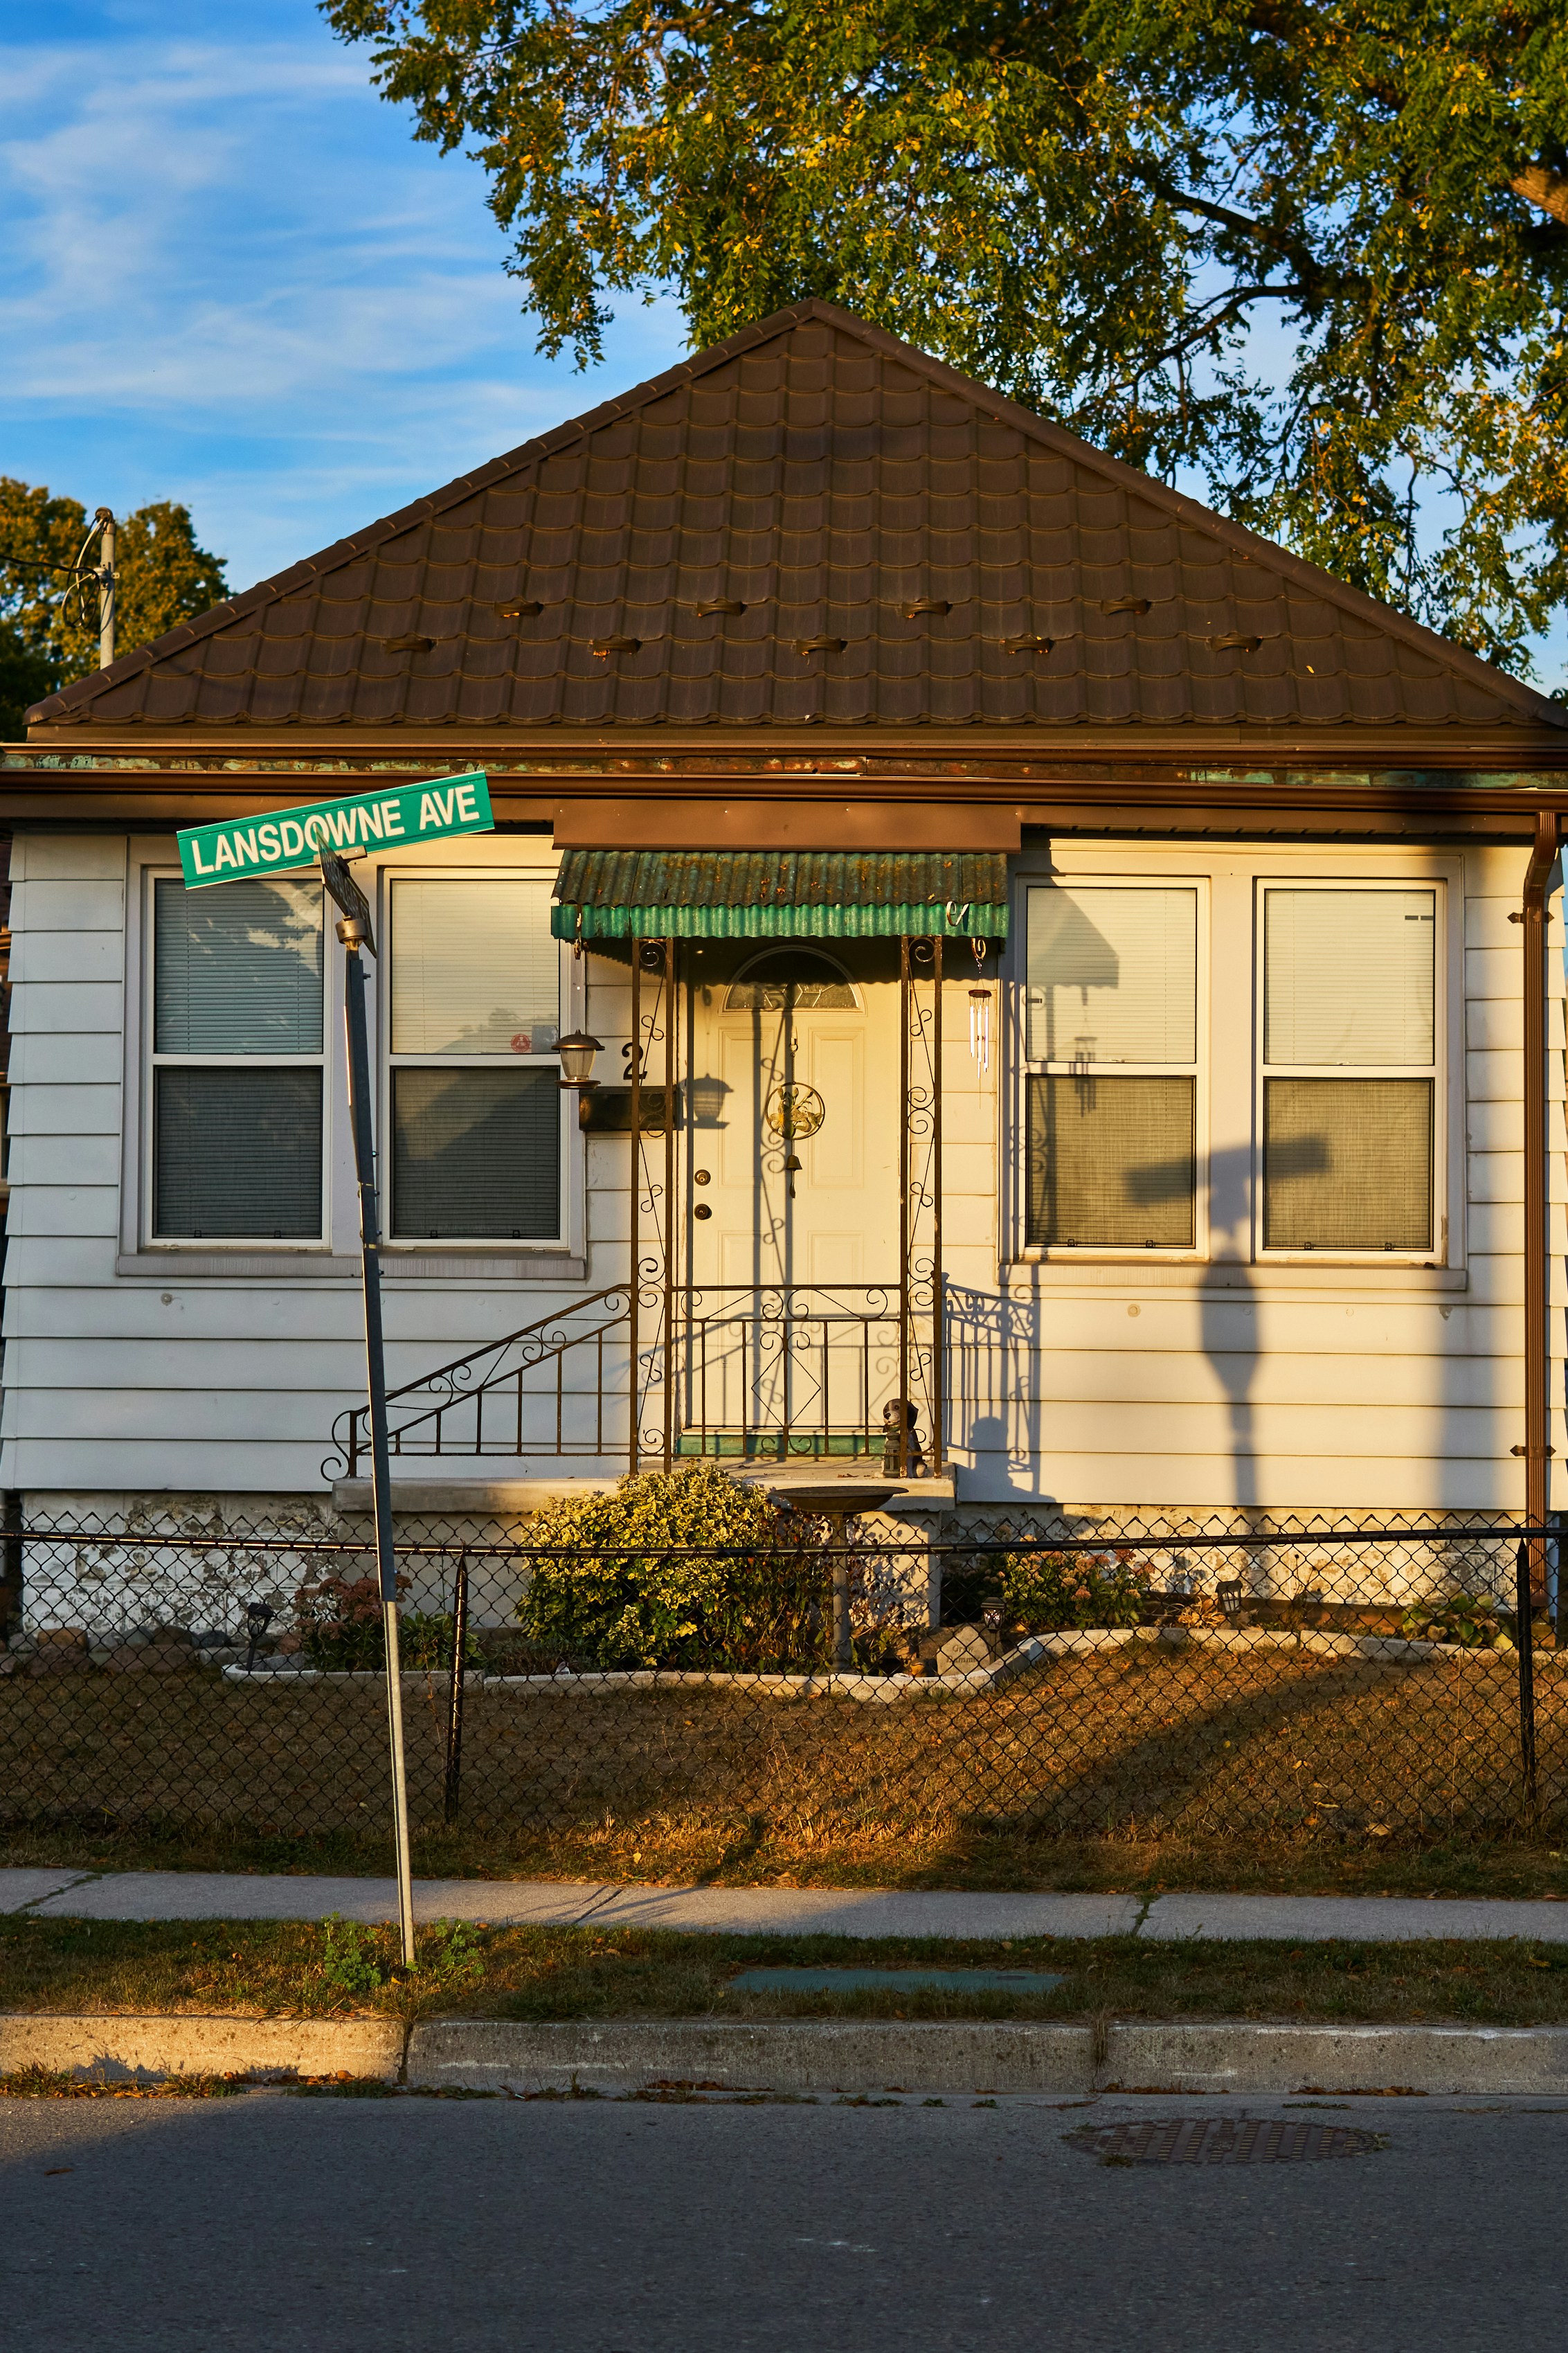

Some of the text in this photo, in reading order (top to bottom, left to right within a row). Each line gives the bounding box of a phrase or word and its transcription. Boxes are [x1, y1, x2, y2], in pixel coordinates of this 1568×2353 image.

[191, 785, 480, 875] LANSDOWNE AVE
[622, 1042, 647, 1080] 2
